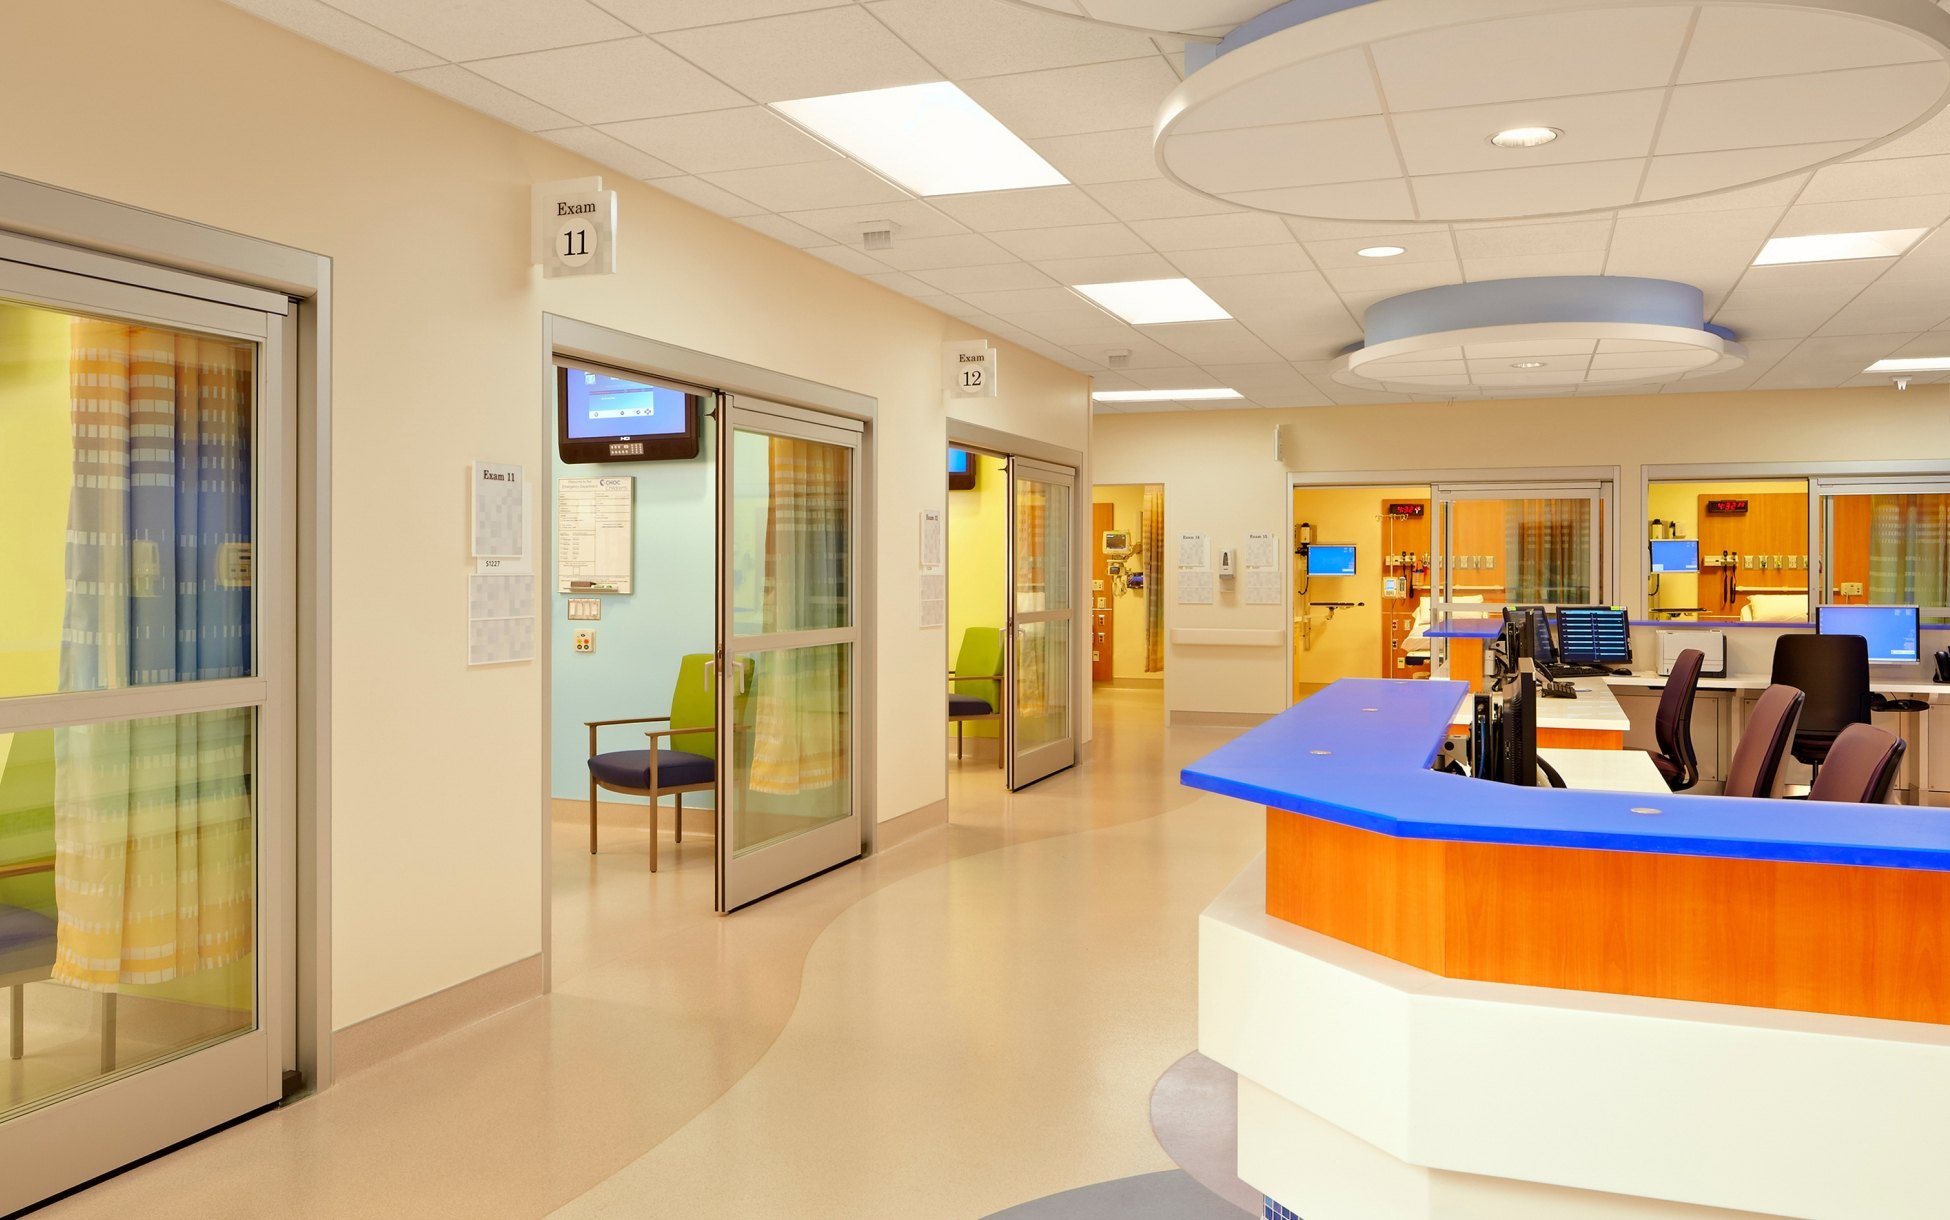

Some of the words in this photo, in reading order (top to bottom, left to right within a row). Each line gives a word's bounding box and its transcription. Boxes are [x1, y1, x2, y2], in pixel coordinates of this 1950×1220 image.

[557, 202, 596, 216] Exam
[563, 229, 589, 256] 11
[959, 353, 985, 363] Exam
[963, 370, 982, 387] 12
[483, 469, 505, 481] Exam
[507, 472, 515, 482] 11
[485, 560, 501, 568] S1227
